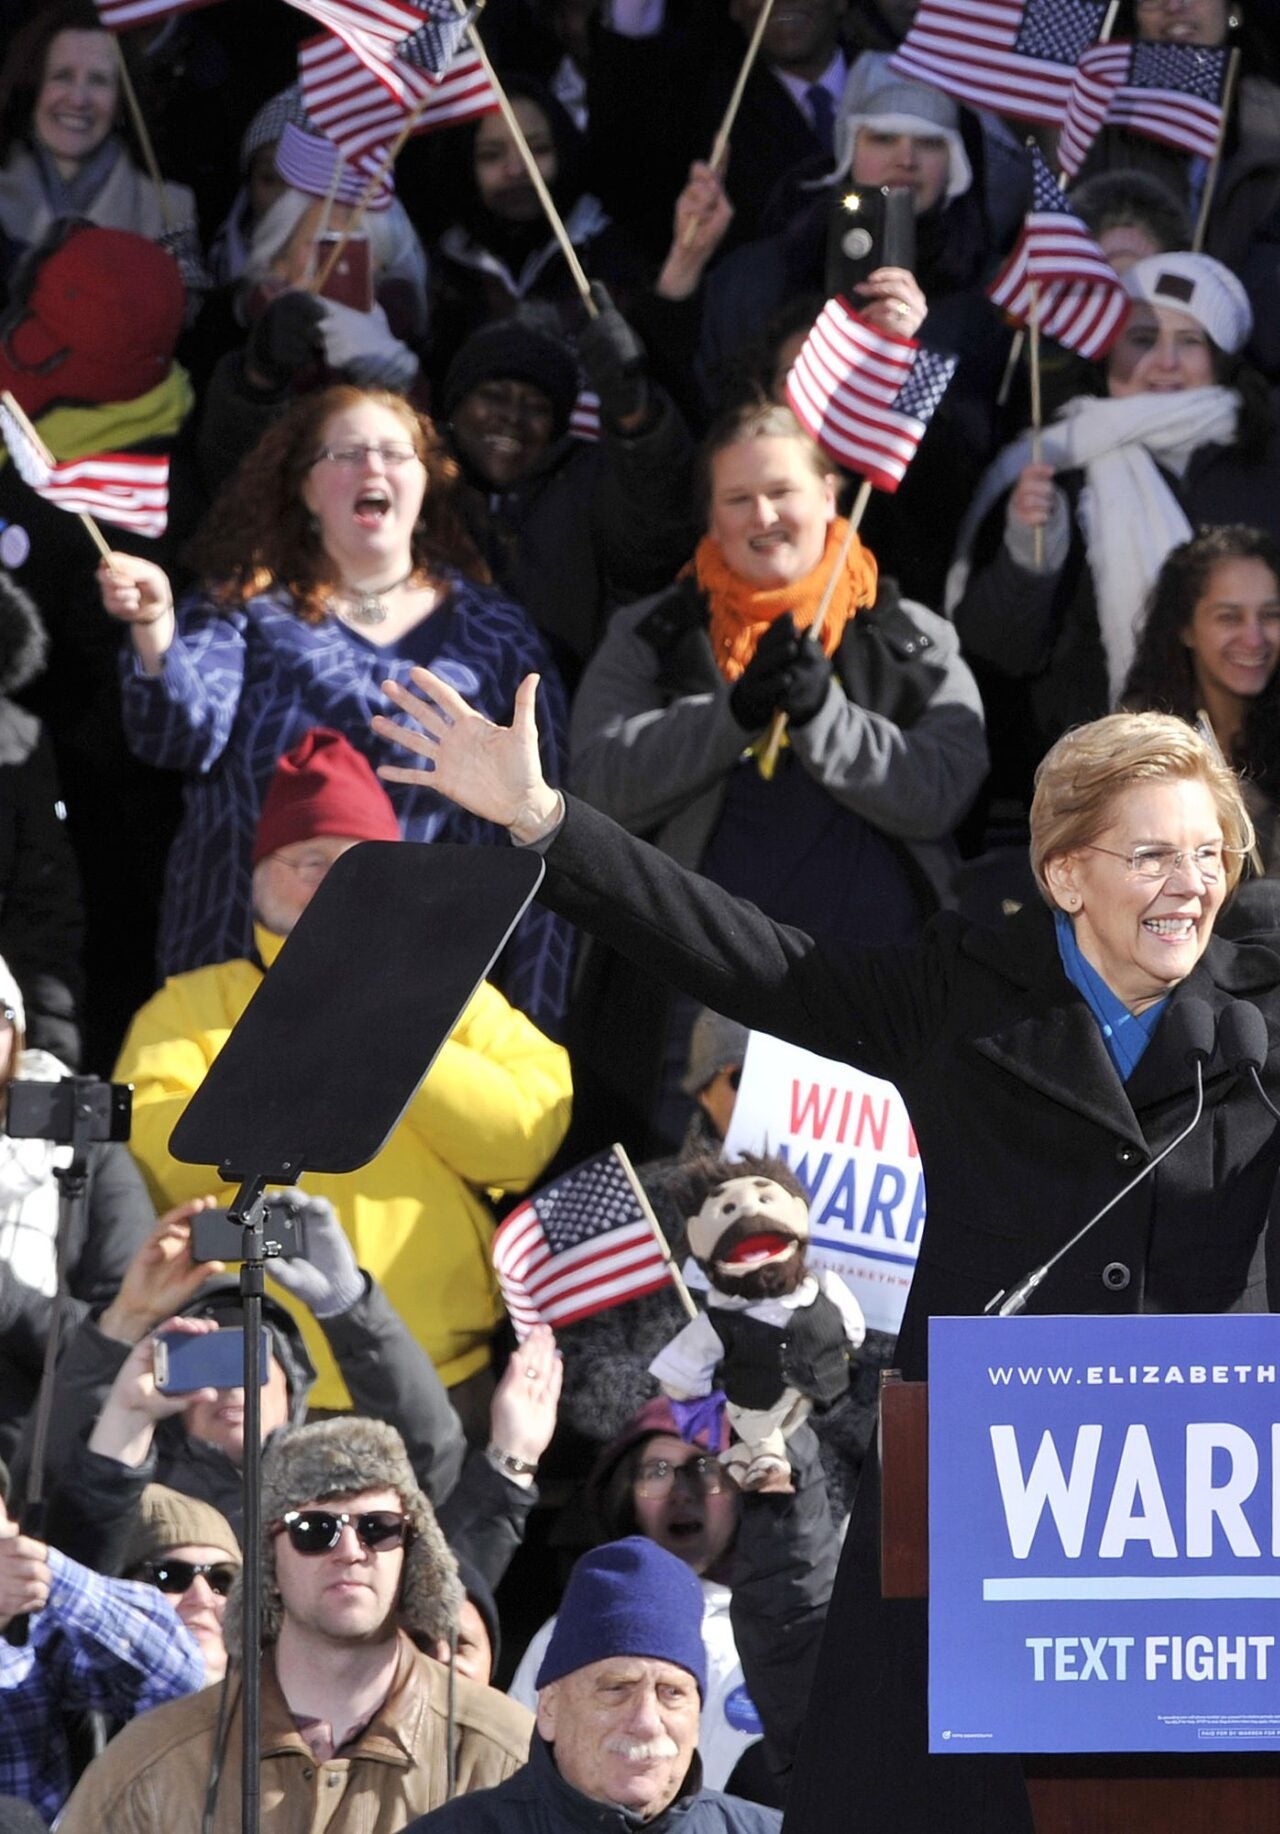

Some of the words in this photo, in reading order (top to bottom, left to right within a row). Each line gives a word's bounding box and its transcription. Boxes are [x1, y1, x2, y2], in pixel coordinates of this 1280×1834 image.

[789, 1079, 891, 1152] WIN
[1025, 1636, 1135, 1682] TEXT
[1145, 1635, 1275, 1682] FIGHT
